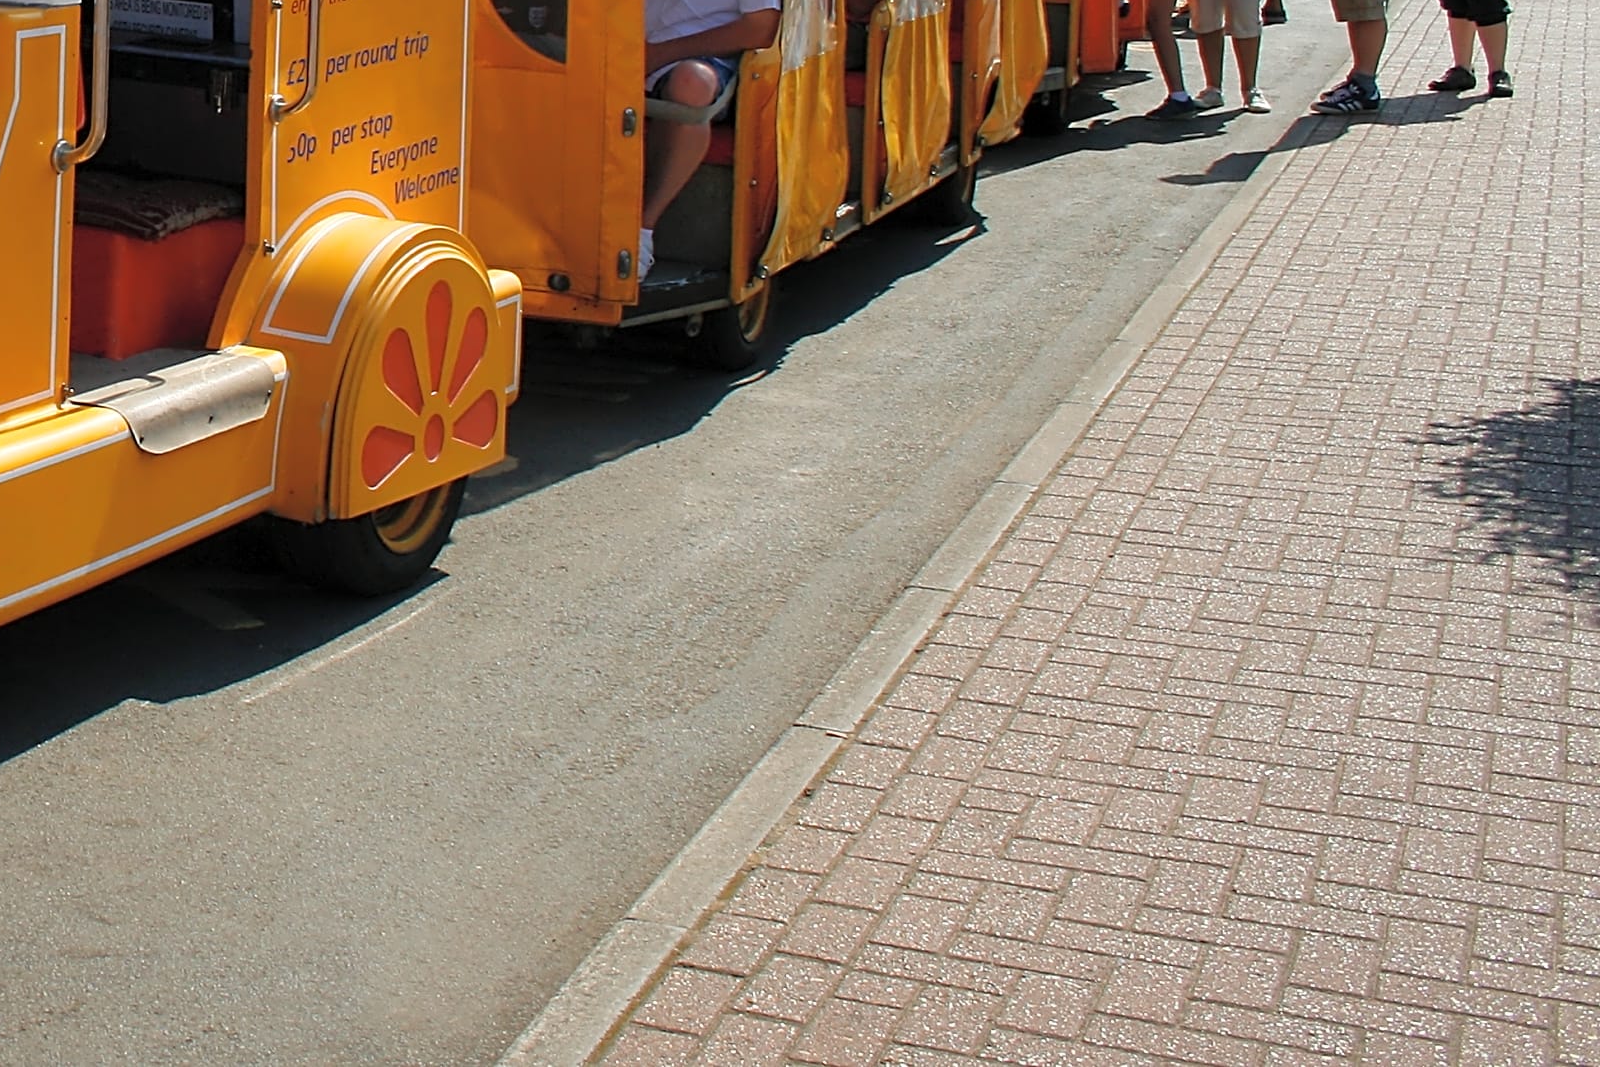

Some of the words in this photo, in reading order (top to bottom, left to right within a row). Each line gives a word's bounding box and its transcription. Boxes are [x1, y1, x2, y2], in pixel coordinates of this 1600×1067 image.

[325, 53, 352, 83] per
[353, 38, 399, 71] round
[403, 30, 430, 60] trip
[330, 124, 357, 155] per
[360, 112, 394, 140] stop
[370, 135, 439, 175] Everyone
[393, 164, 460, 204] Welcome
